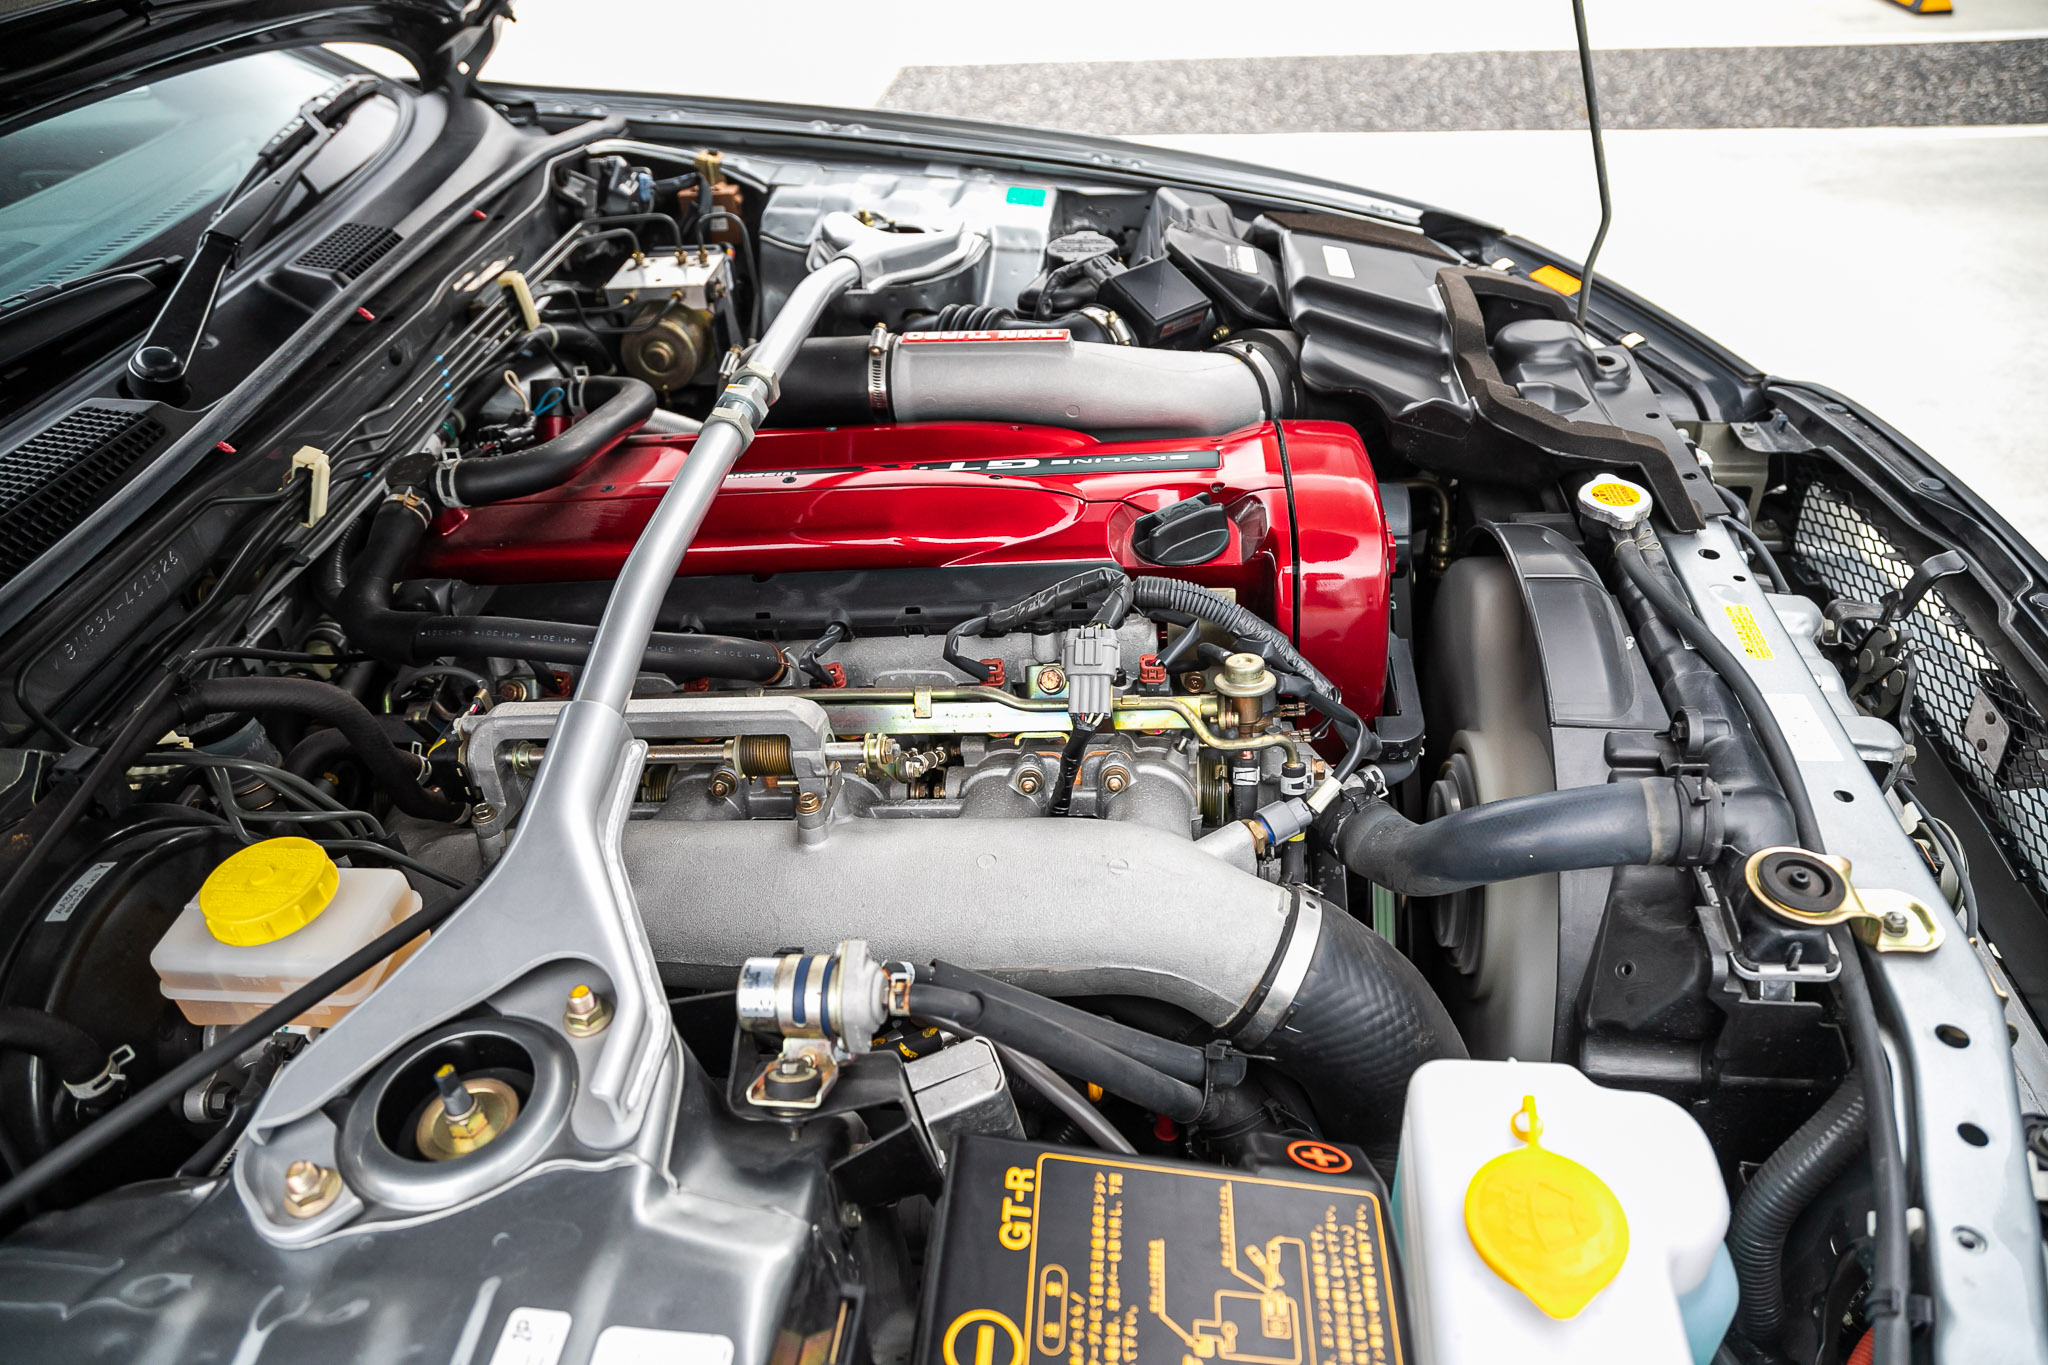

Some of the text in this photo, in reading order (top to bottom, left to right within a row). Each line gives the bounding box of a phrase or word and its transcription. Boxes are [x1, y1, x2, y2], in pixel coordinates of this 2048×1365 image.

[907, 329, 1063, 340] TWIN TURBO
[1050, 455, 1190, 466] SKYLINE
[998, 1166, 1036, 1251] GT-R
